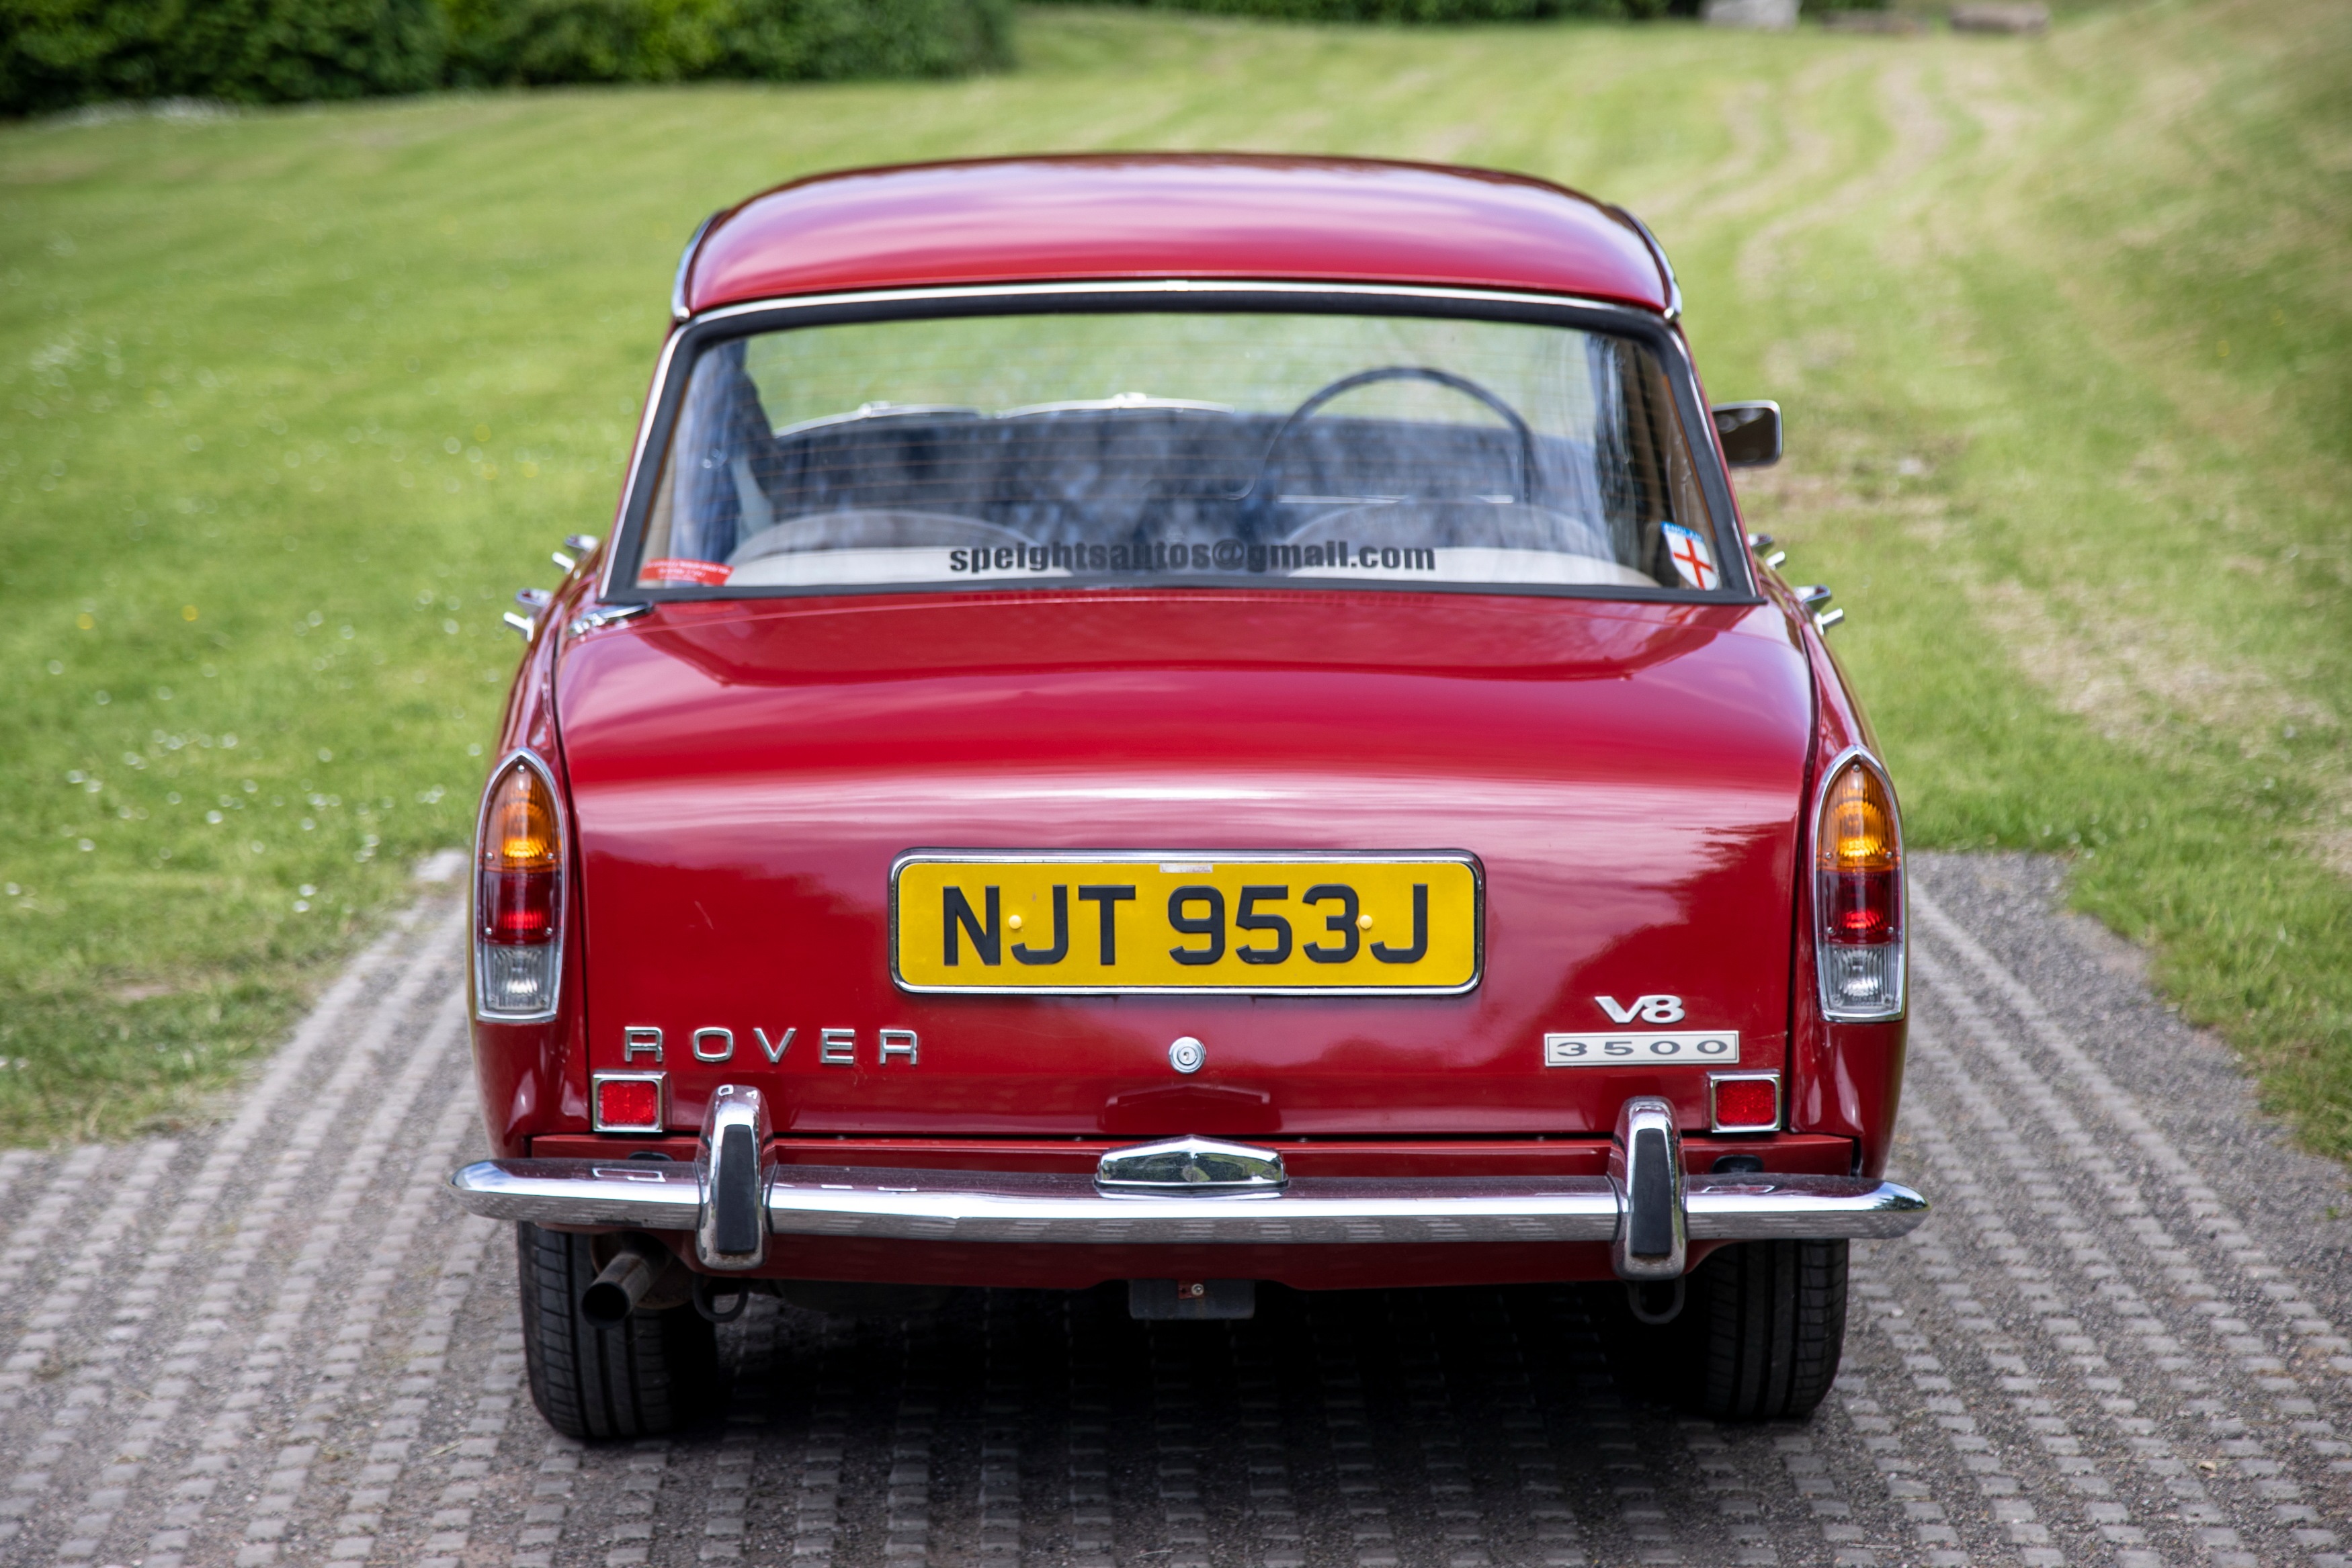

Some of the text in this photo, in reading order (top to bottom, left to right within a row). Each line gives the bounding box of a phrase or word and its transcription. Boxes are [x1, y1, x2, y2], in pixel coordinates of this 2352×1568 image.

[949, 539, 1436, 574] speightsautos@gmail.com
[942, 883, 1429, 966] NJT 953J
[1595, 994, 1685, 1024] V8
[624, 1025, 918, 1065] ROVER
[1556, 1039, 1728, 1057] 3500
